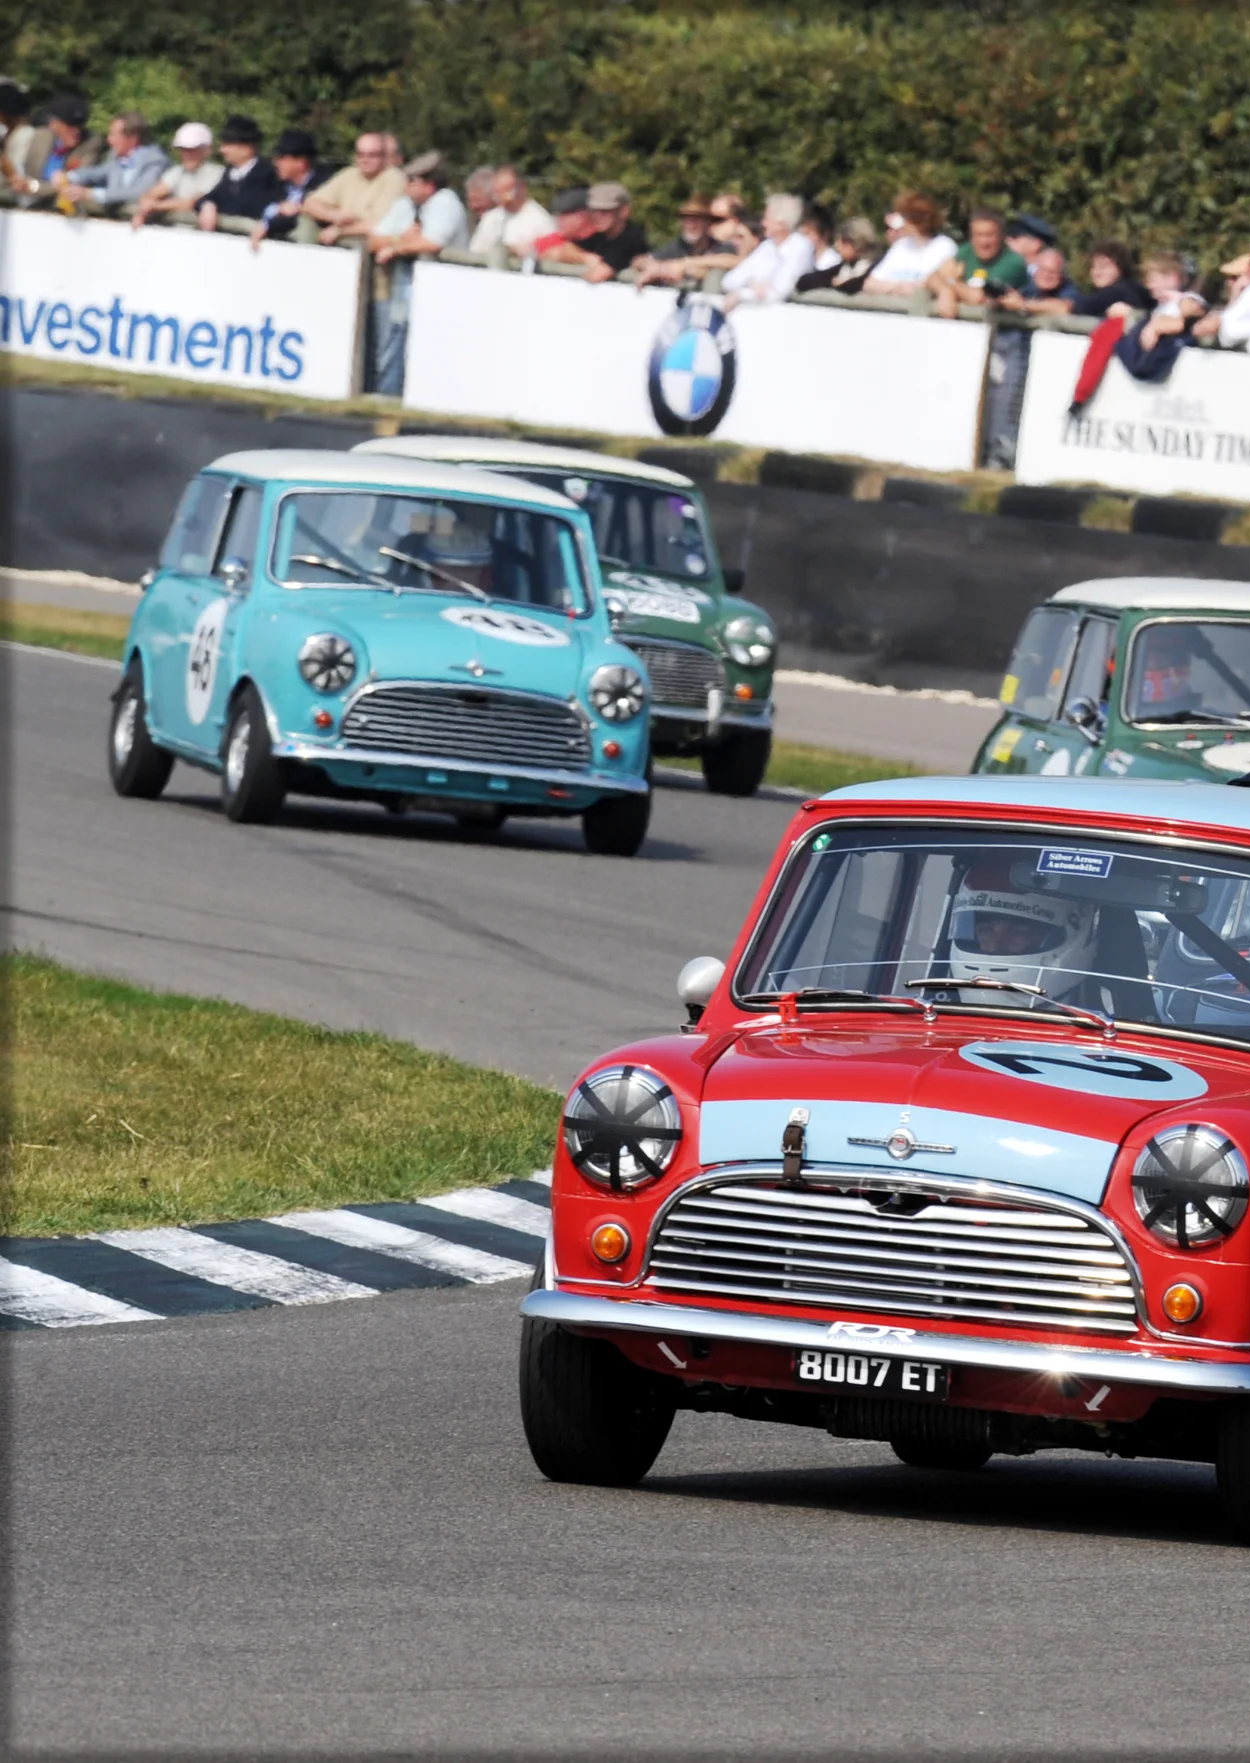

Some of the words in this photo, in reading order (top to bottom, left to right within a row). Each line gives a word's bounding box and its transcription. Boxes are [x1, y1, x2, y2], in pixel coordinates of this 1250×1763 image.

[1113, 419, 1206, 461] SUNDAY
[1046, 861, 1101, 873] Automobiles
[799, 1350, 891, 1387] 8007
[901, 1361, 942, 1392] ET
